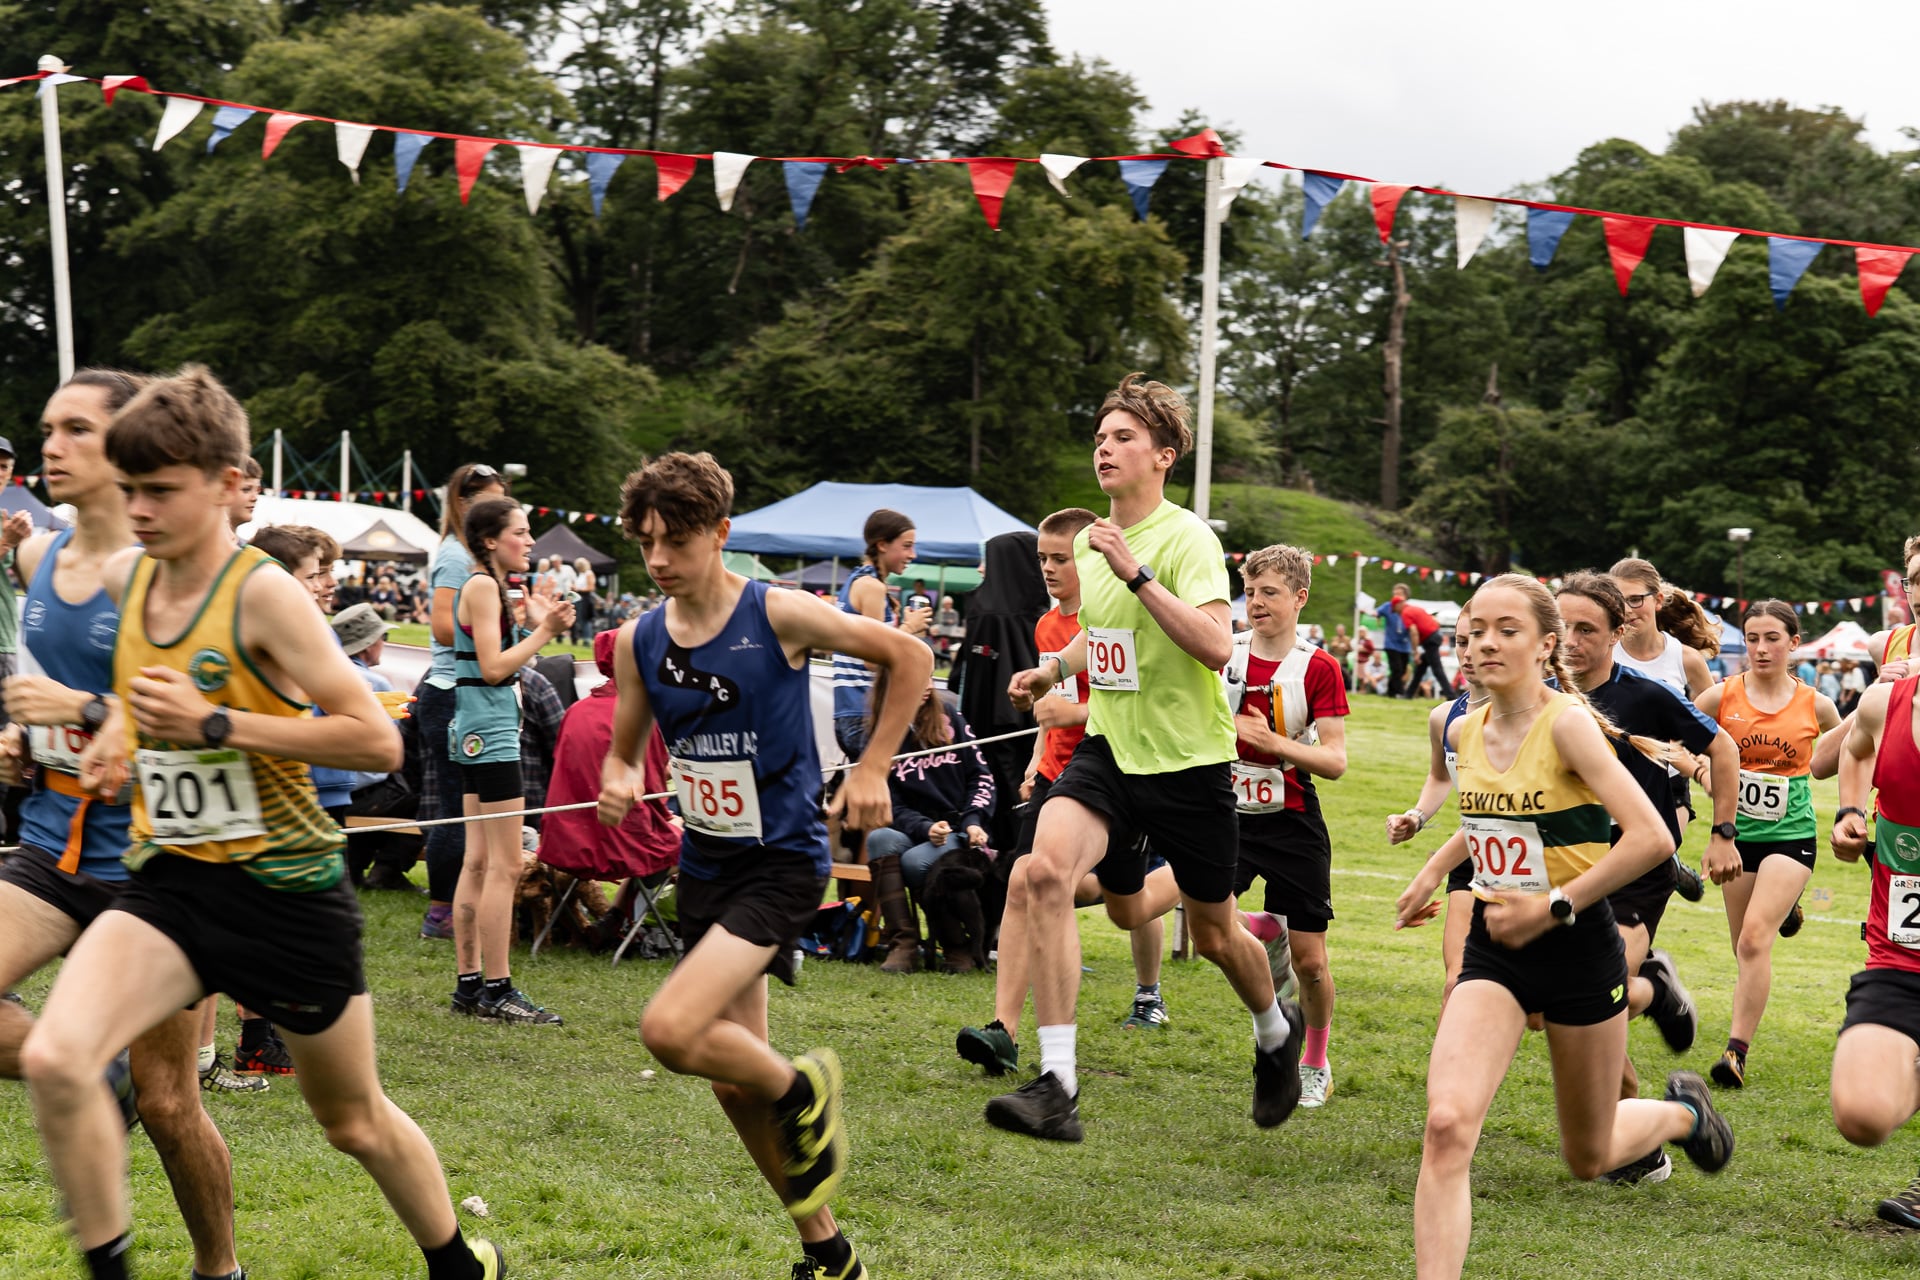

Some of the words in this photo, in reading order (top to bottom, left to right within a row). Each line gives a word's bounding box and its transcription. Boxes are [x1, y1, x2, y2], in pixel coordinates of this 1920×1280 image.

[1088, 640, 1126, 674] 790
[693, 732, 738, 757] VALLEY
[149, 768, 239, 819] 201
[681, 774, 744, 817] 785
[1459, 791, 1517, 812] ESWICK
[1521, 790, 1545, 812] AC
[1469, 835, 1532, 876] 302
